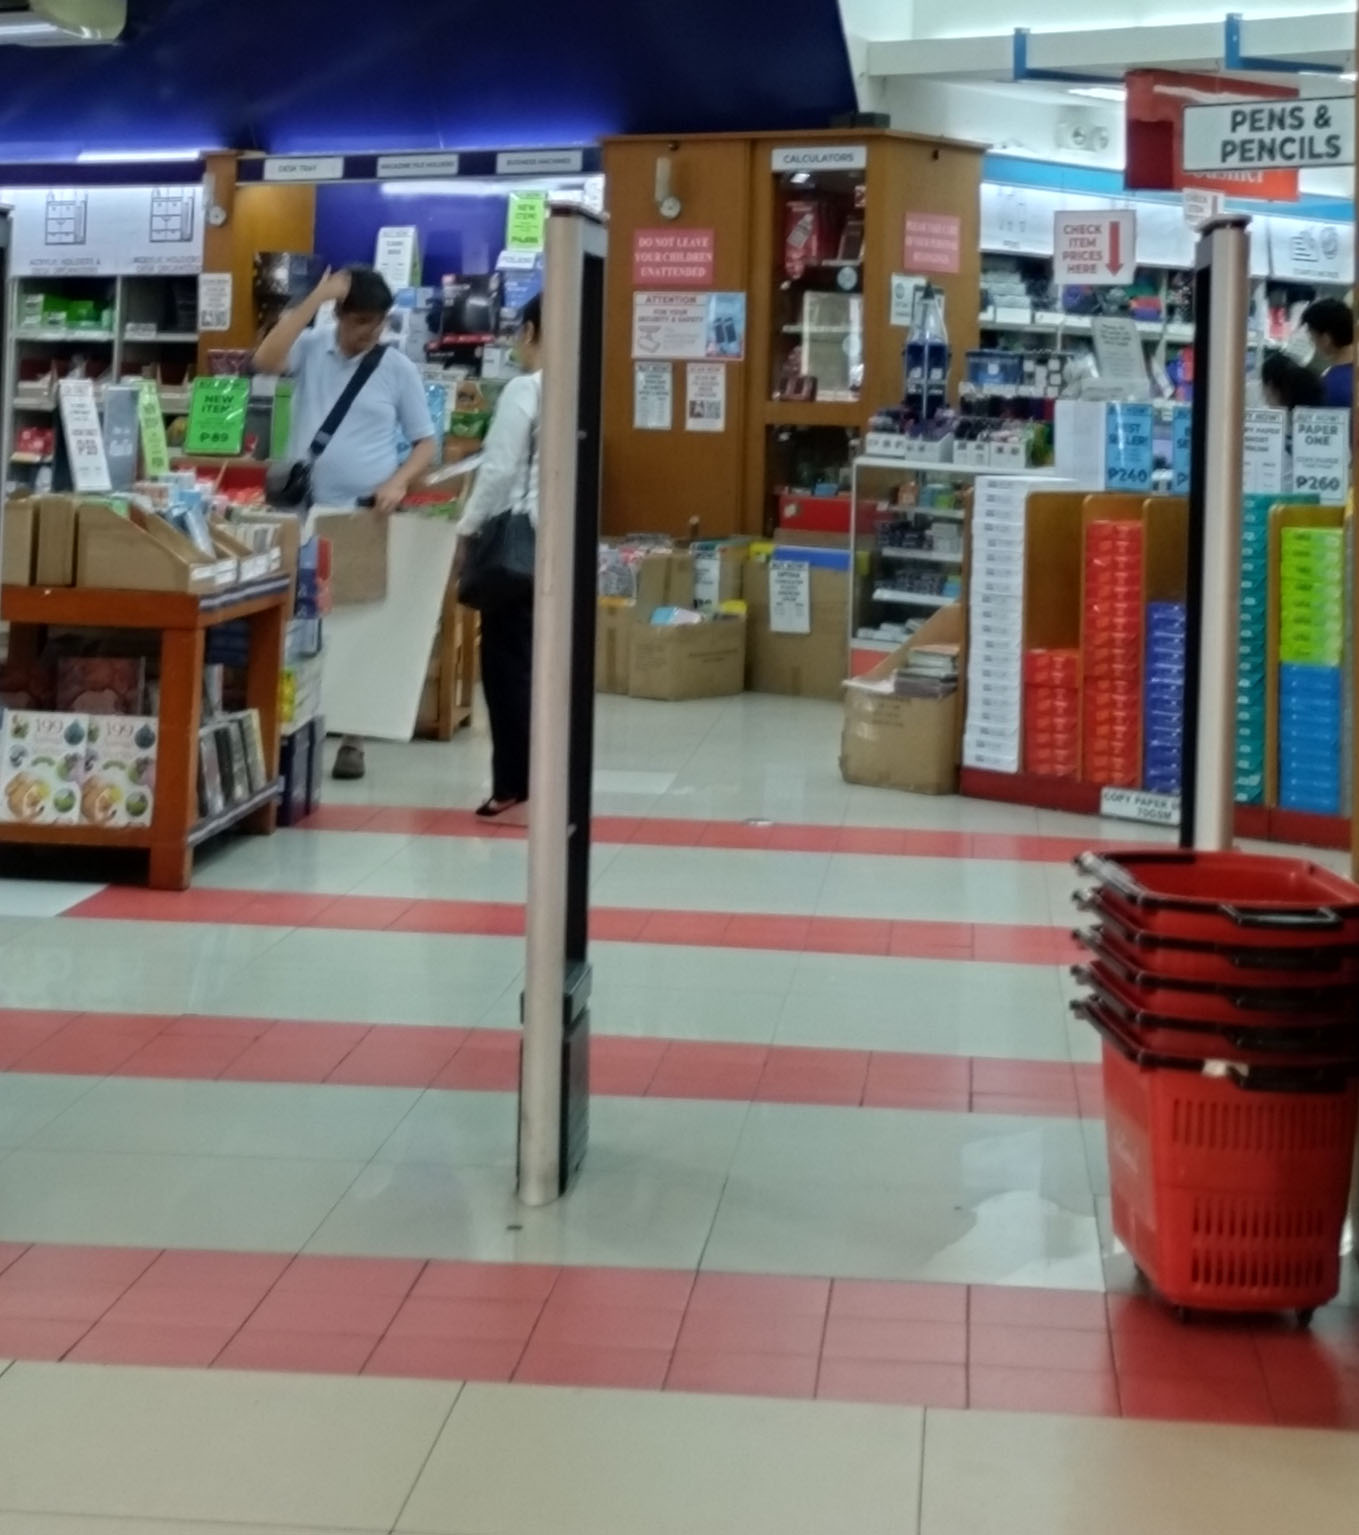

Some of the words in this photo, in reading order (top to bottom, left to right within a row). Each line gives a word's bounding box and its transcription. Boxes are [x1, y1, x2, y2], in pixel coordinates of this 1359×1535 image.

[1230, 105, 1306, 134] PENS
[1313, 104, 1332, 130] &
[1219, 134, 1342, 164] PENCILS
[783, 152, 854, 164] CALCULATORS
[1063, 223, 1103, 235] CHECK
[638, 237, 653, 248] DO
[655, 237, 674, 248] NOT
[1068, 236, 1097, 248] ITEM
[1061, 250, 1103, 262] PRICES
[1066, 263, 1098, 274] HERE
[644, 295, 697, 304] ATTENTION
[203, 394, 235, 404] NEW
[1297, 423, 1339, 436] PAPER
[1304, 435, 1331, 447] ONE
